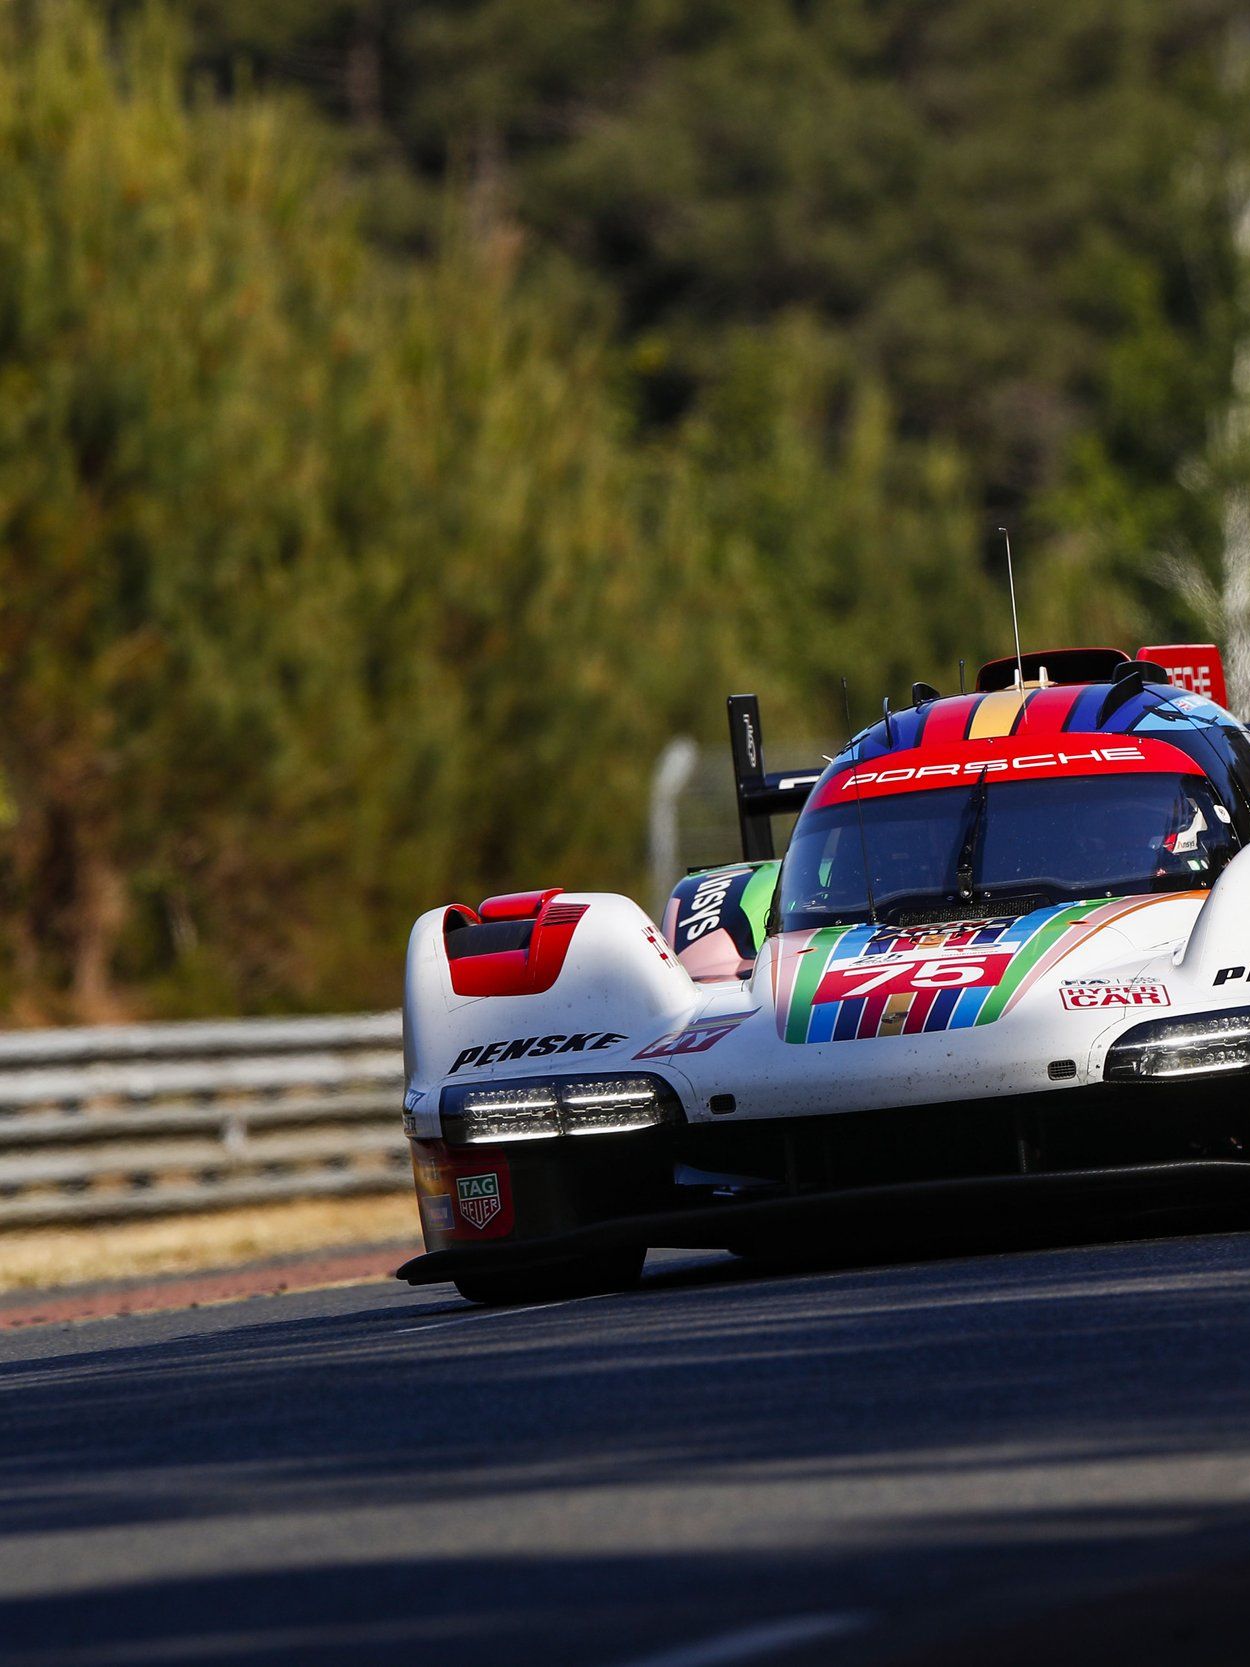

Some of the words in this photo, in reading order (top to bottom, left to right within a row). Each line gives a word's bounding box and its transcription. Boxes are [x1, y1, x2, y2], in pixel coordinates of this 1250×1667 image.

[841, 747, 1146, 790] PORSCHE
[841, 956, 986, 998] 75
[1067, 986, 1158, 996] HYPER
[1070, 992, 1161, 1007] CAR
[447, 1032, 630, 1075] PENSKE
[460, 1178, 494, 1197] TAG
[460, 1199, 498, 1225] HEUER
